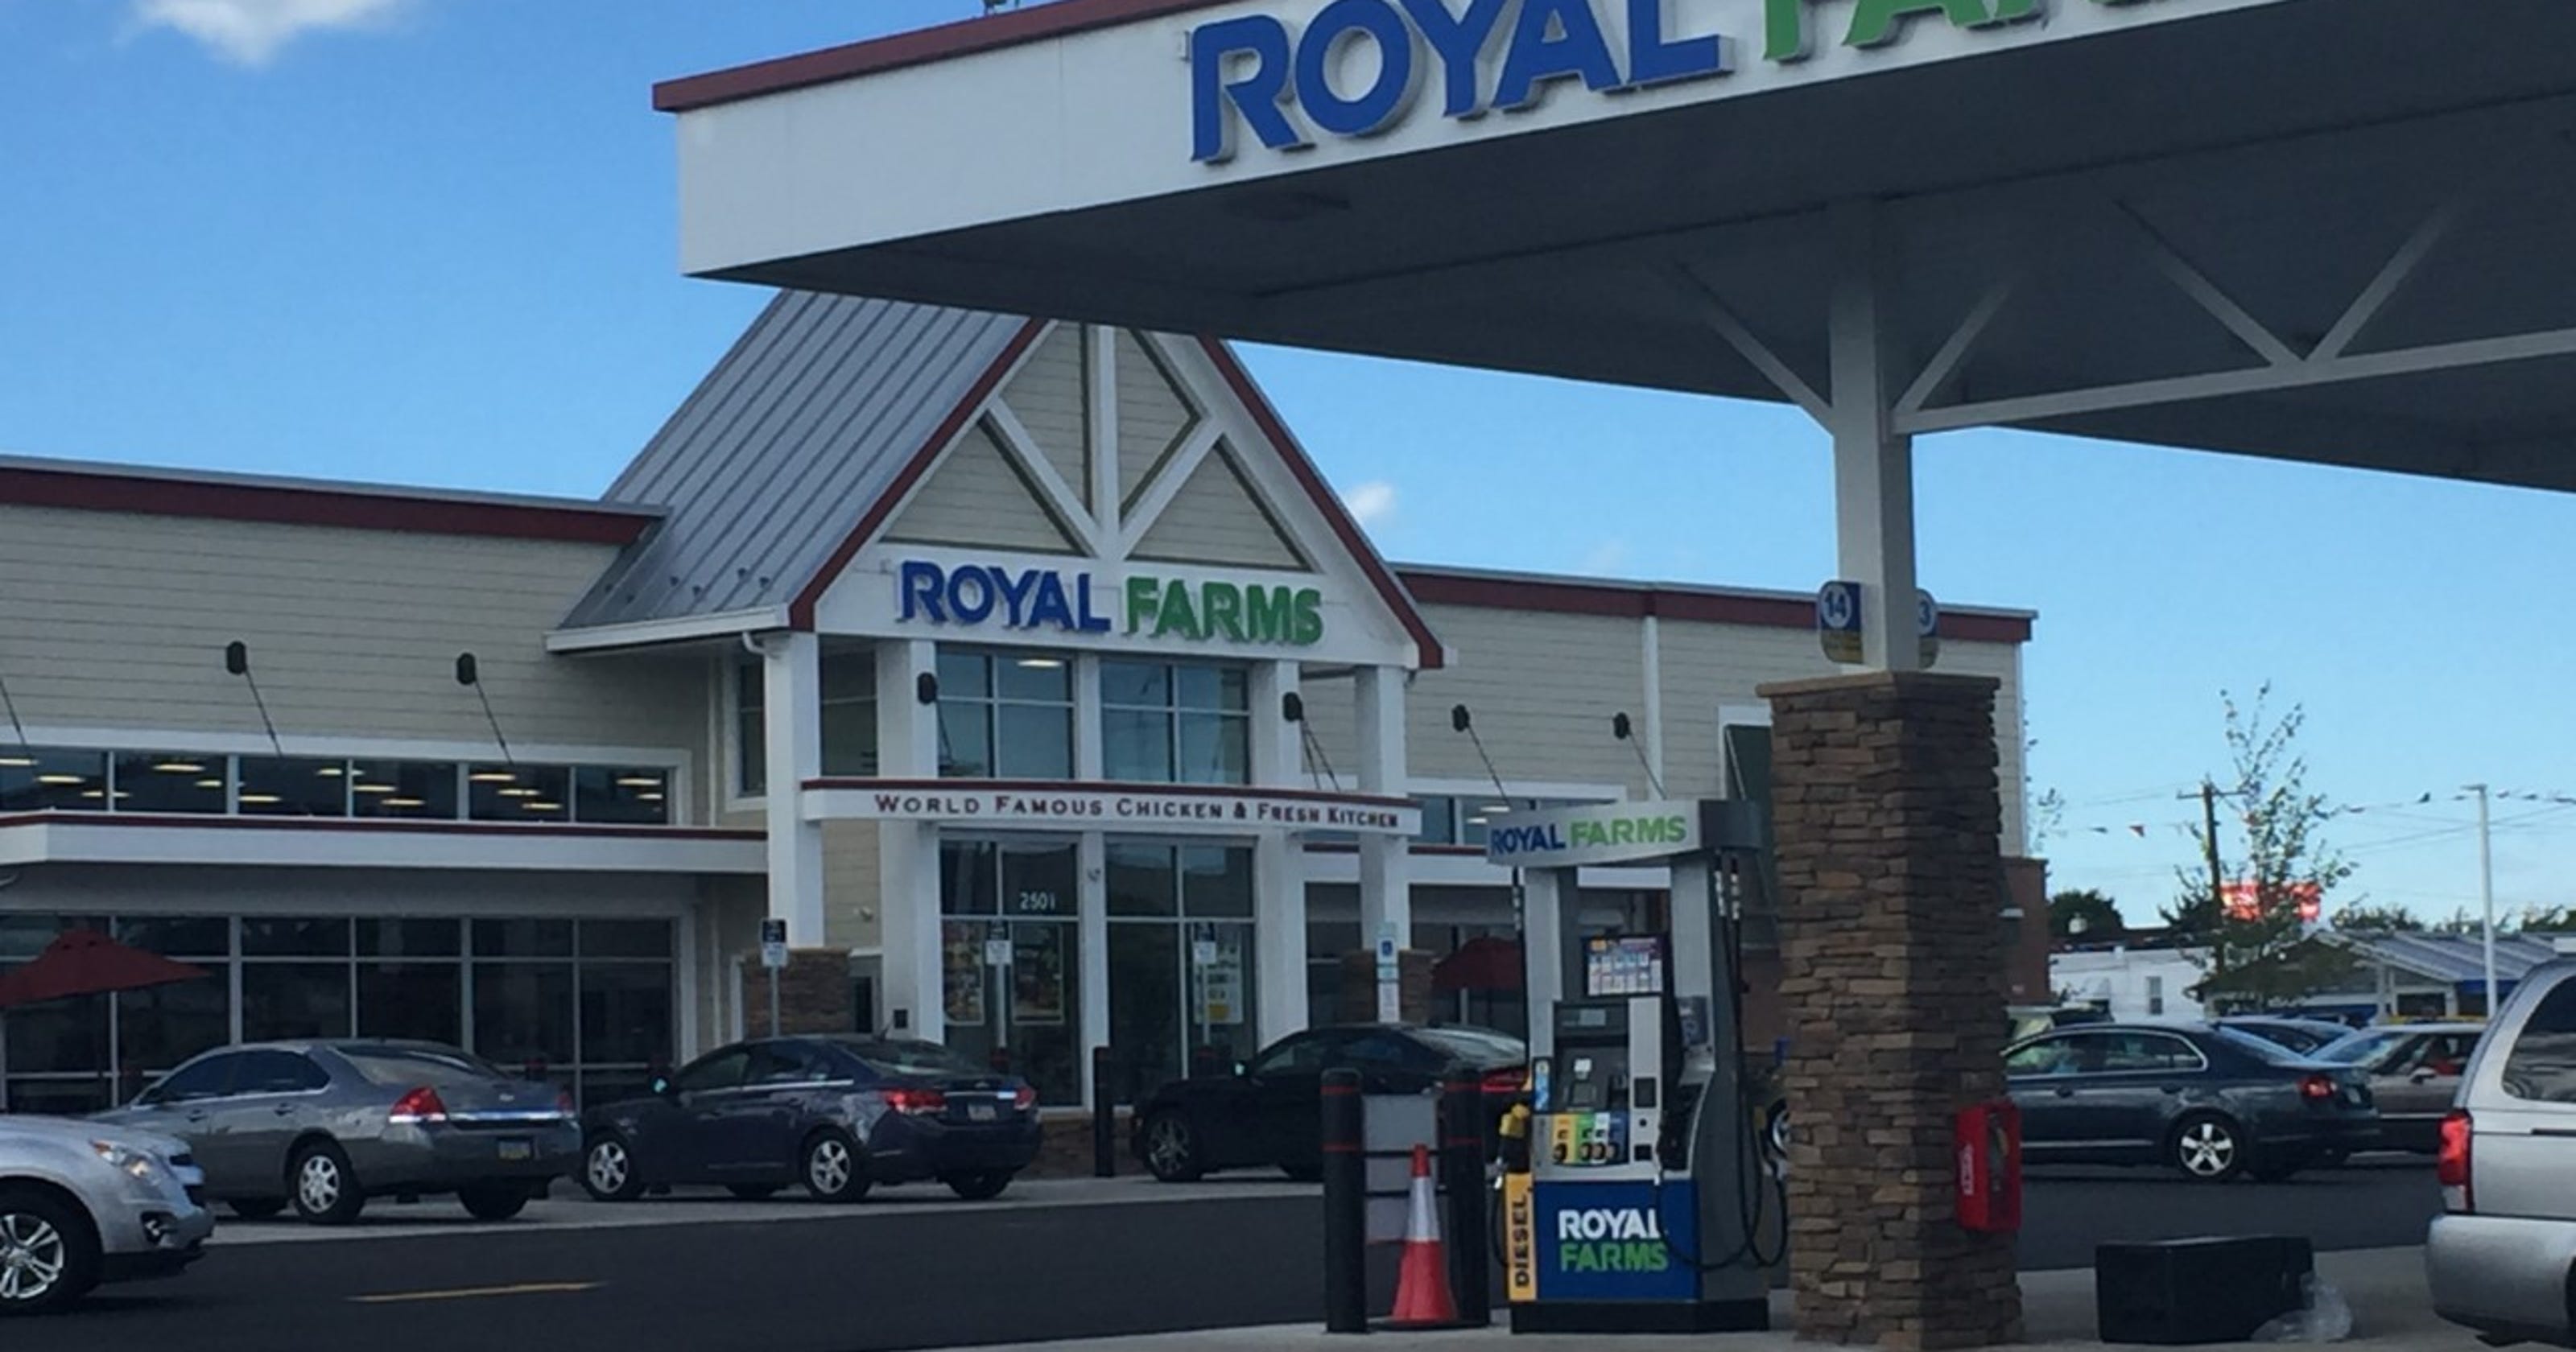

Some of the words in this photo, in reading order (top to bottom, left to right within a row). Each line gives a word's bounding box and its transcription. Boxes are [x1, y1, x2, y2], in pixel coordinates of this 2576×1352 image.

[1190, 0, 1731, 163] ROYAL
[898, 560, 1112, 633] ROYAL
[1124, 576, 1324, 645] FARMS
[1825, 591, 1847, 619] 14
[874, 793, 980, 814] WORLD
[995, 795, 1104, 816] FAMOUS
[1117, 798, 1223, 819] CHICKEN
[1233, 801, 1247, 820] &
[1257, 802, 1319, 823] FRESH
[1327, 806, 1398, 828] KITCHEN
[1491, 822, 1567, 856] ROYAL
[1571, 815, 1687, 848] FARMS
[1019, 891, 1056, 910] 2501
[1513, 1193, 1530, 1288] DIESEL
[1558, 1209, 1663, 1241] ROYAL
[1560, 1242, 1669, 1273] FARMS
